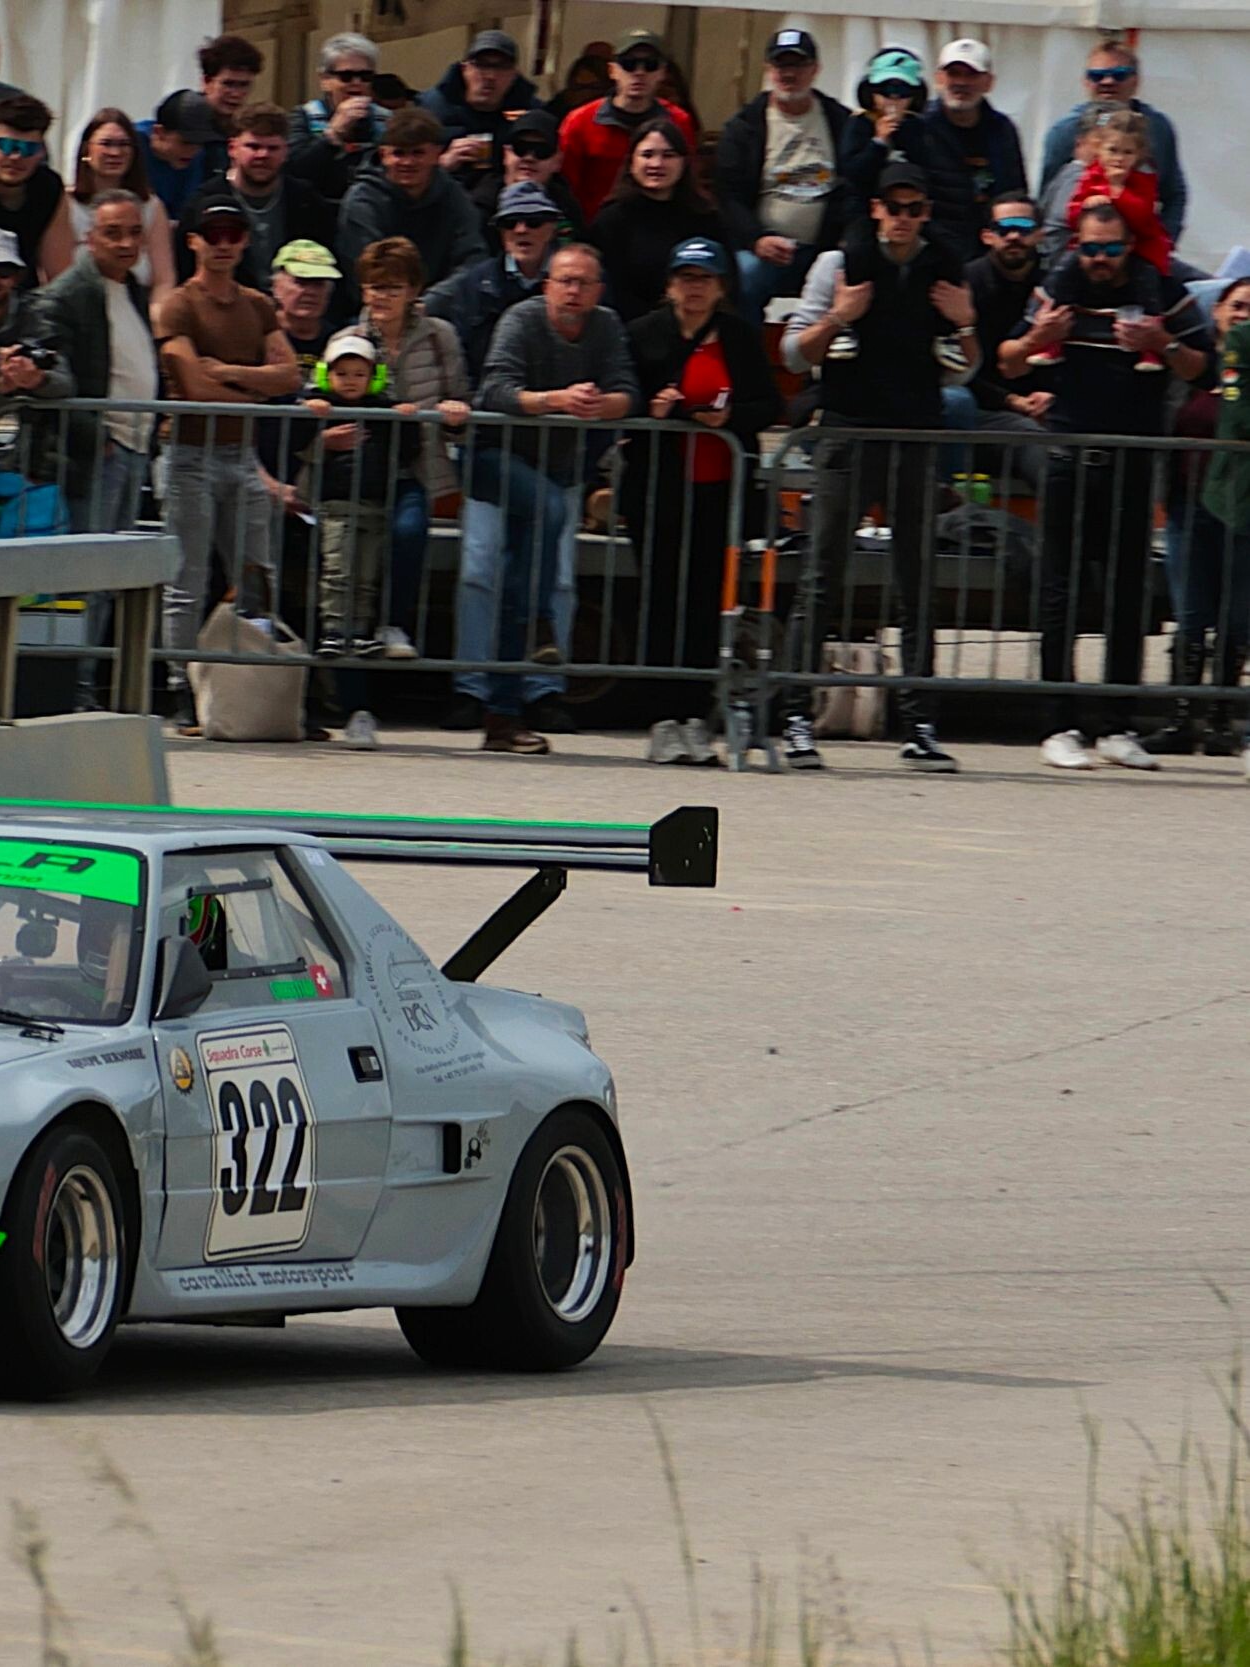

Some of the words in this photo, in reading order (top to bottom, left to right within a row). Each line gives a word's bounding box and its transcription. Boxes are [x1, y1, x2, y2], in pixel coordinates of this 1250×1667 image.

[206, 1044, 240, 1065] Squadra
[240, 1044, 263, 1059] Corse
[218, 1077, 307, 1216] 322
[179, 1266, 257, 1291] cavallini
[258, 1263, 355, 1289] motorsport
